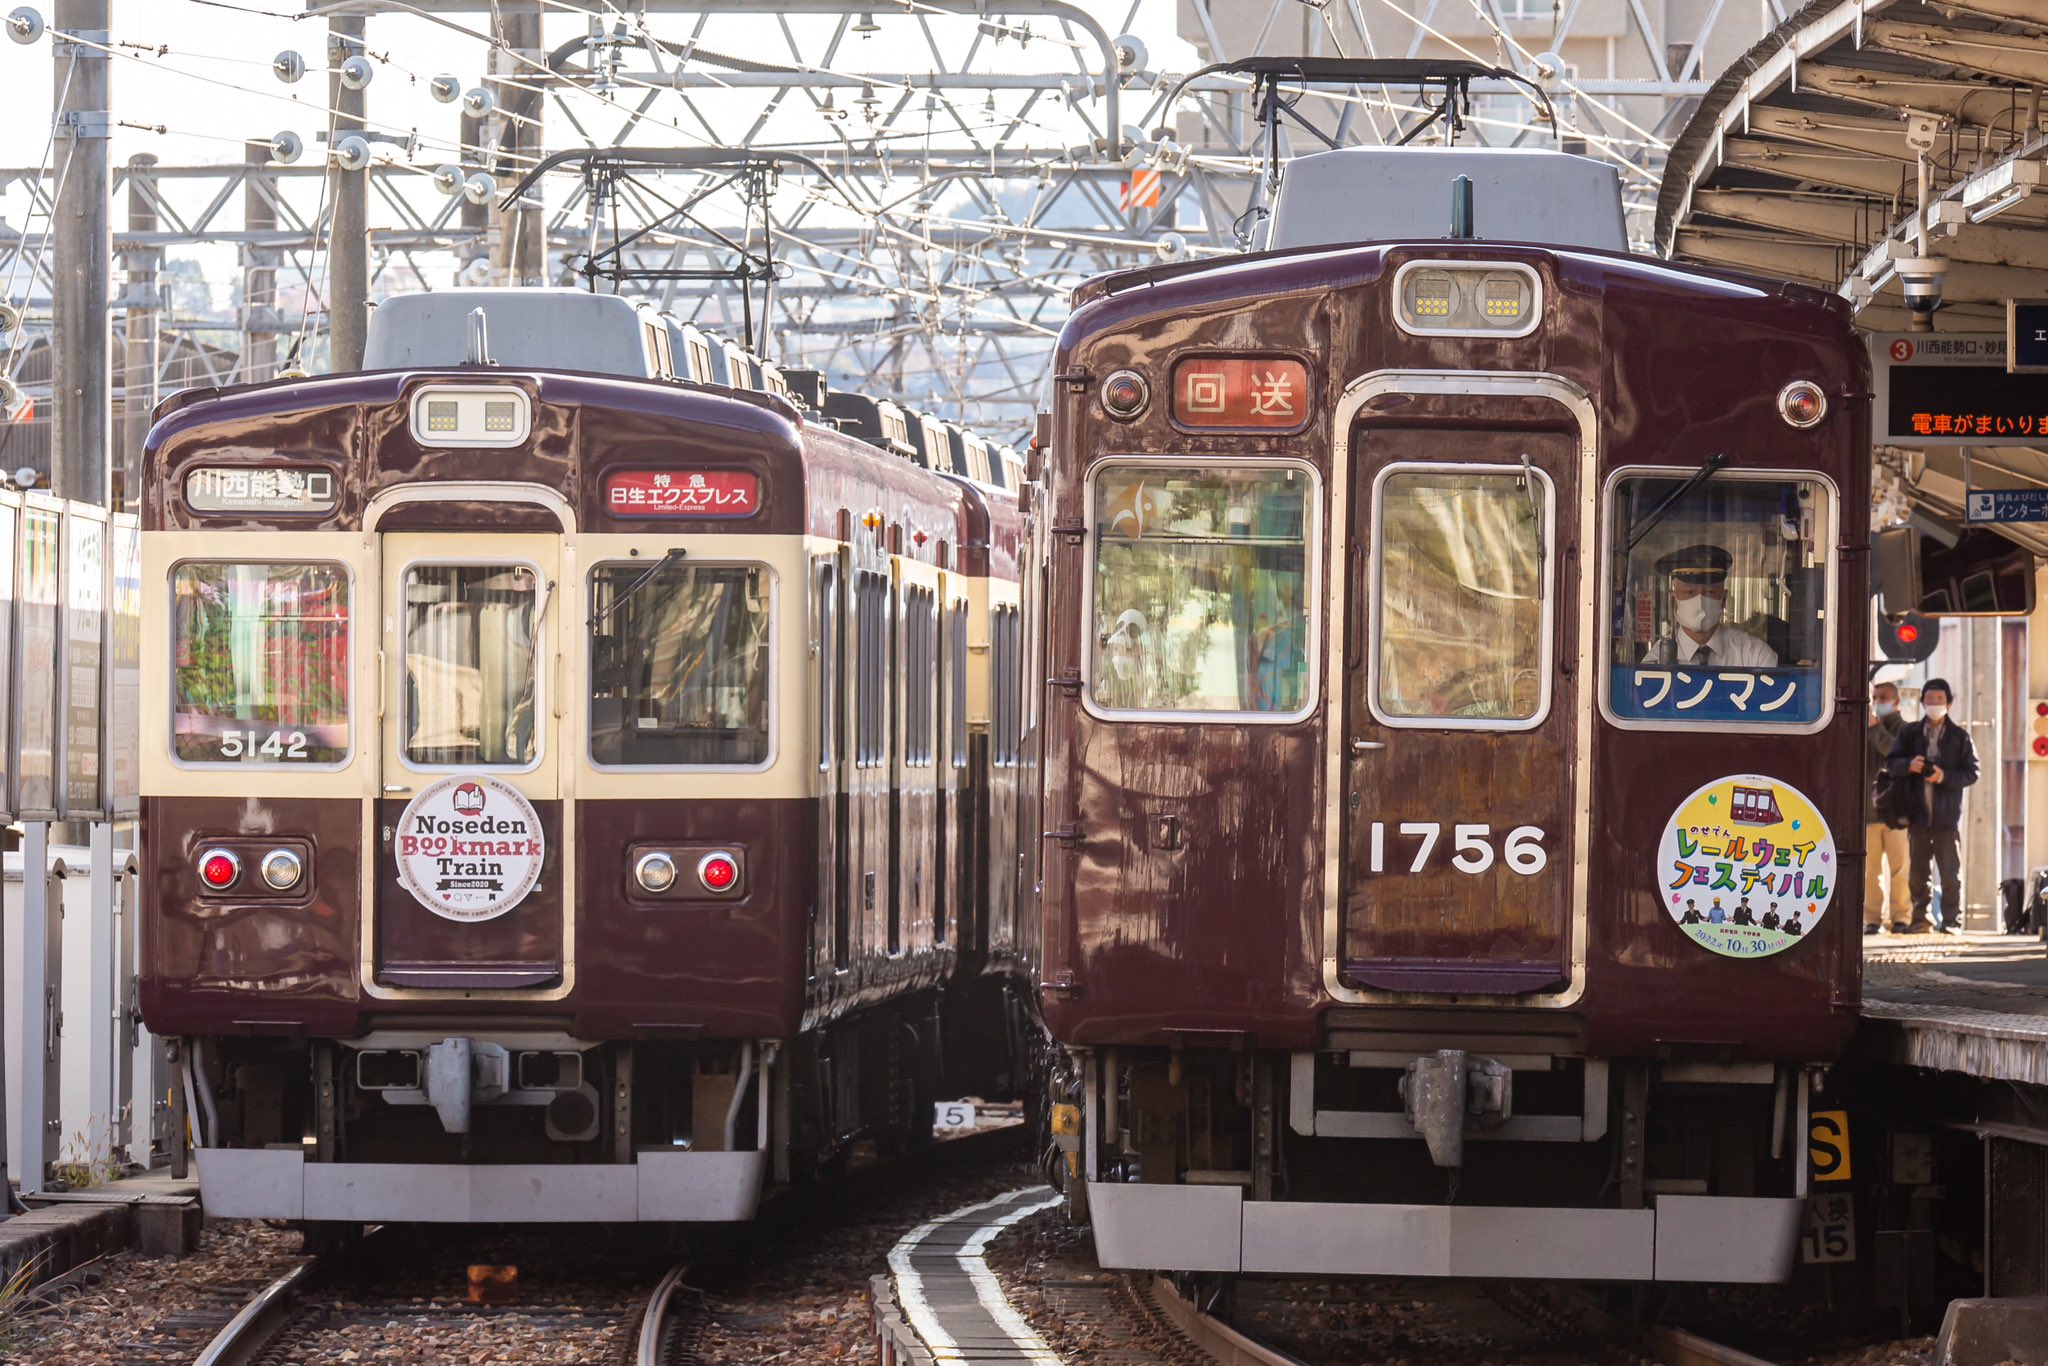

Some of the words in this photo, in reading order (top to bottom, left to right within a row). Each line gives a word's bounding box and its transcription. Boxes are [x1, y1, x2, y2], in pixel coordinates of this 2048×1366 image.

[1895, 342, 1908, 359] 3
[1187, 371, 1294, 416] 回送
[194, 469, 332, 498] 川西能勢口
[653, 474, 706, 488] 特急
[611, 487, 749, 505] 日生エクスプレス
[1634, 671, 1797, 712] ワンマン
[220, 730, 308, 758] 5142
[416, 816, 527, 834] Noseden
[1690, 826, 1731, 837] のせでん
[401, 836, 541, 857] Bookmark
[1370, 822, 1547, 875] 1756
[1676, 829, 1816, 869] レールウェイ
[437, 858, 503, 876] Train
[1669, 860, 1829, 899] フェスティバル
[1810, 1117, 1842, 1175] S
[1803, 1224, 1849, 1259] 15
